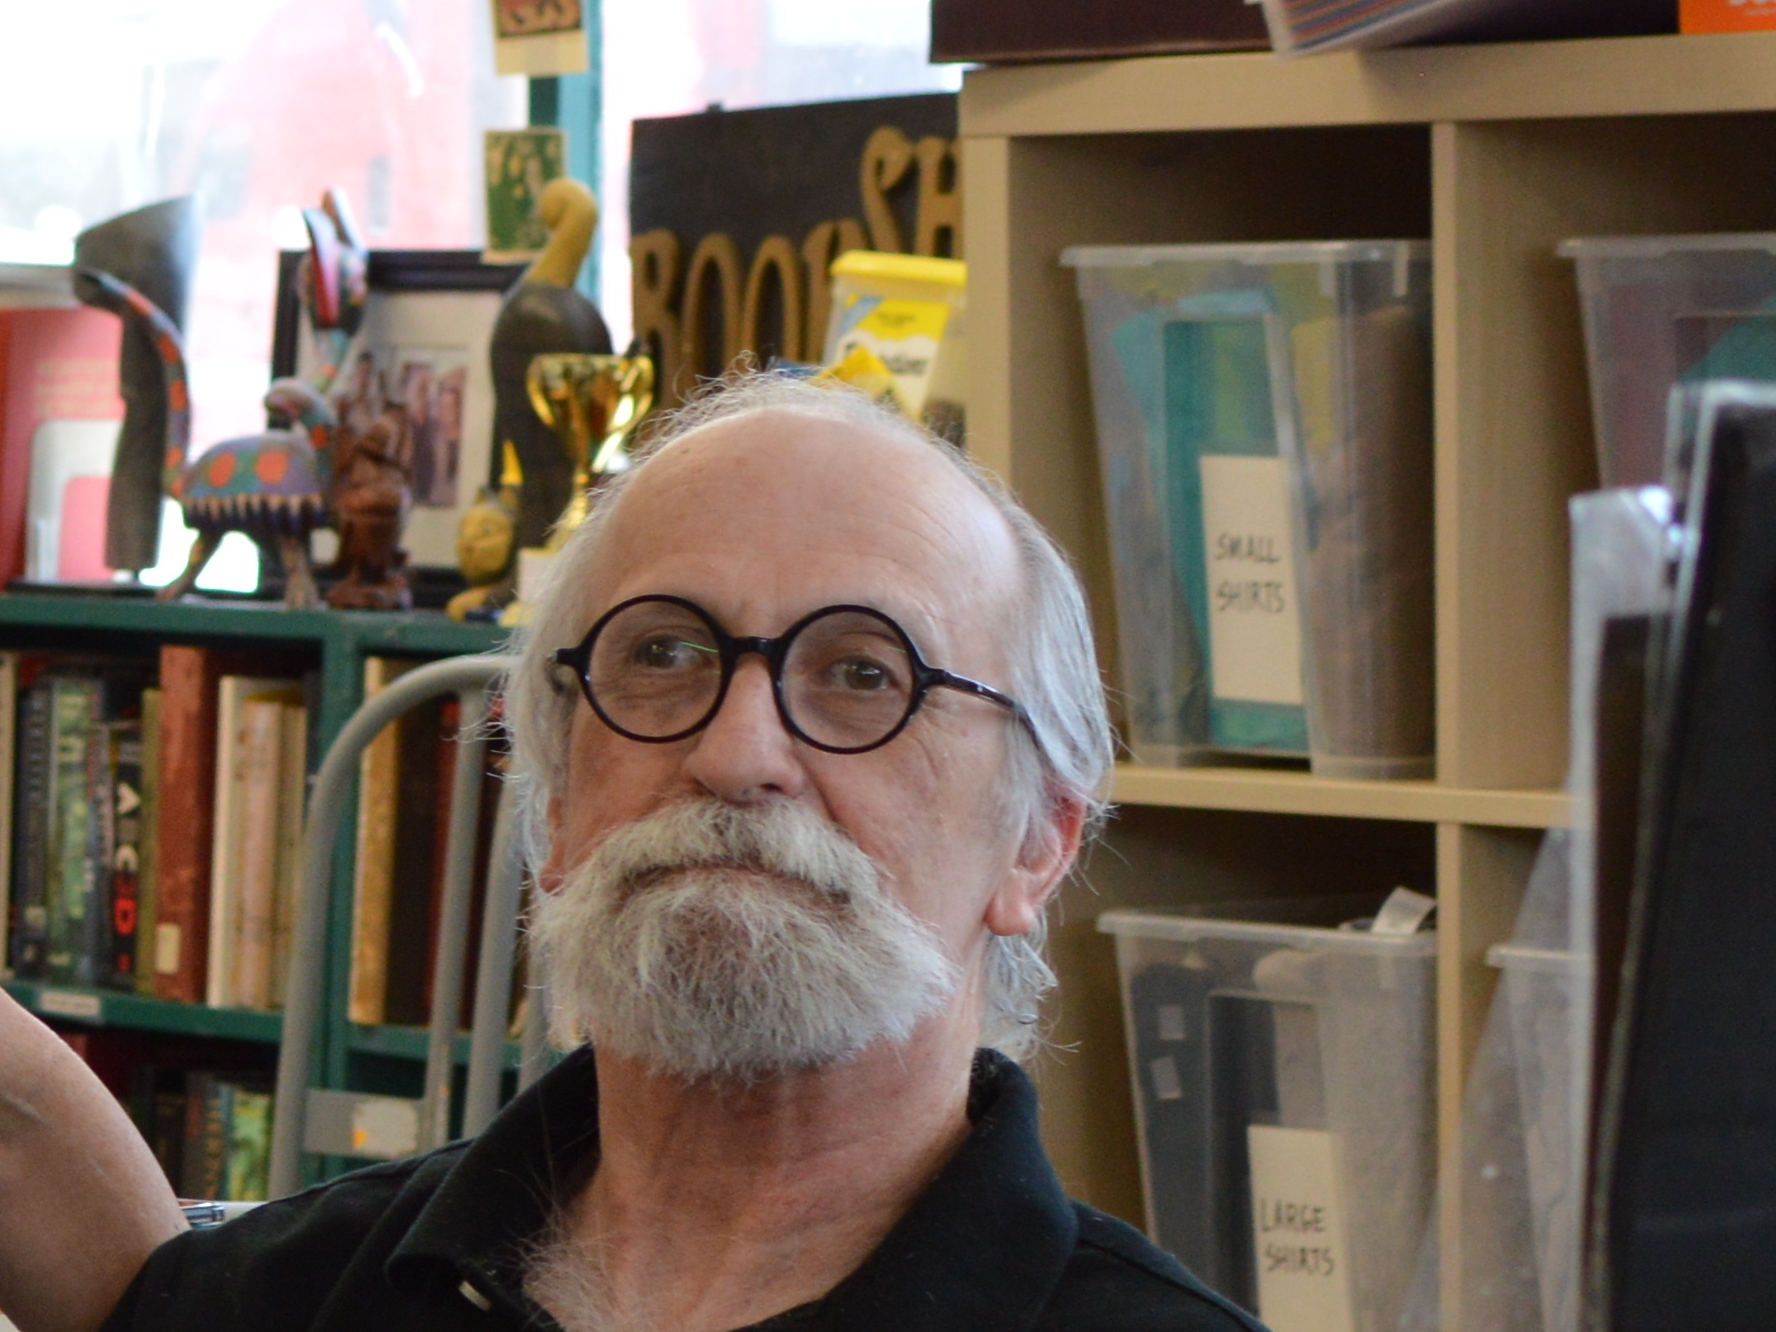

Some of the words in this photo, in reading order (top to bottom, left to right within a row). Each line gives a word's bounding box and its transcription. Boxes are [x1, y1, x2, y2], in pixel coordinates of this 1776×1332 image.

[1215, 531, 1282, 563] SMALL
[1215, 578, 1286, 616] SHIRTS
[1259, 1198, 1326, 1235] LARGE
[1266, 1242, 1335, 1277] SHIRTS
